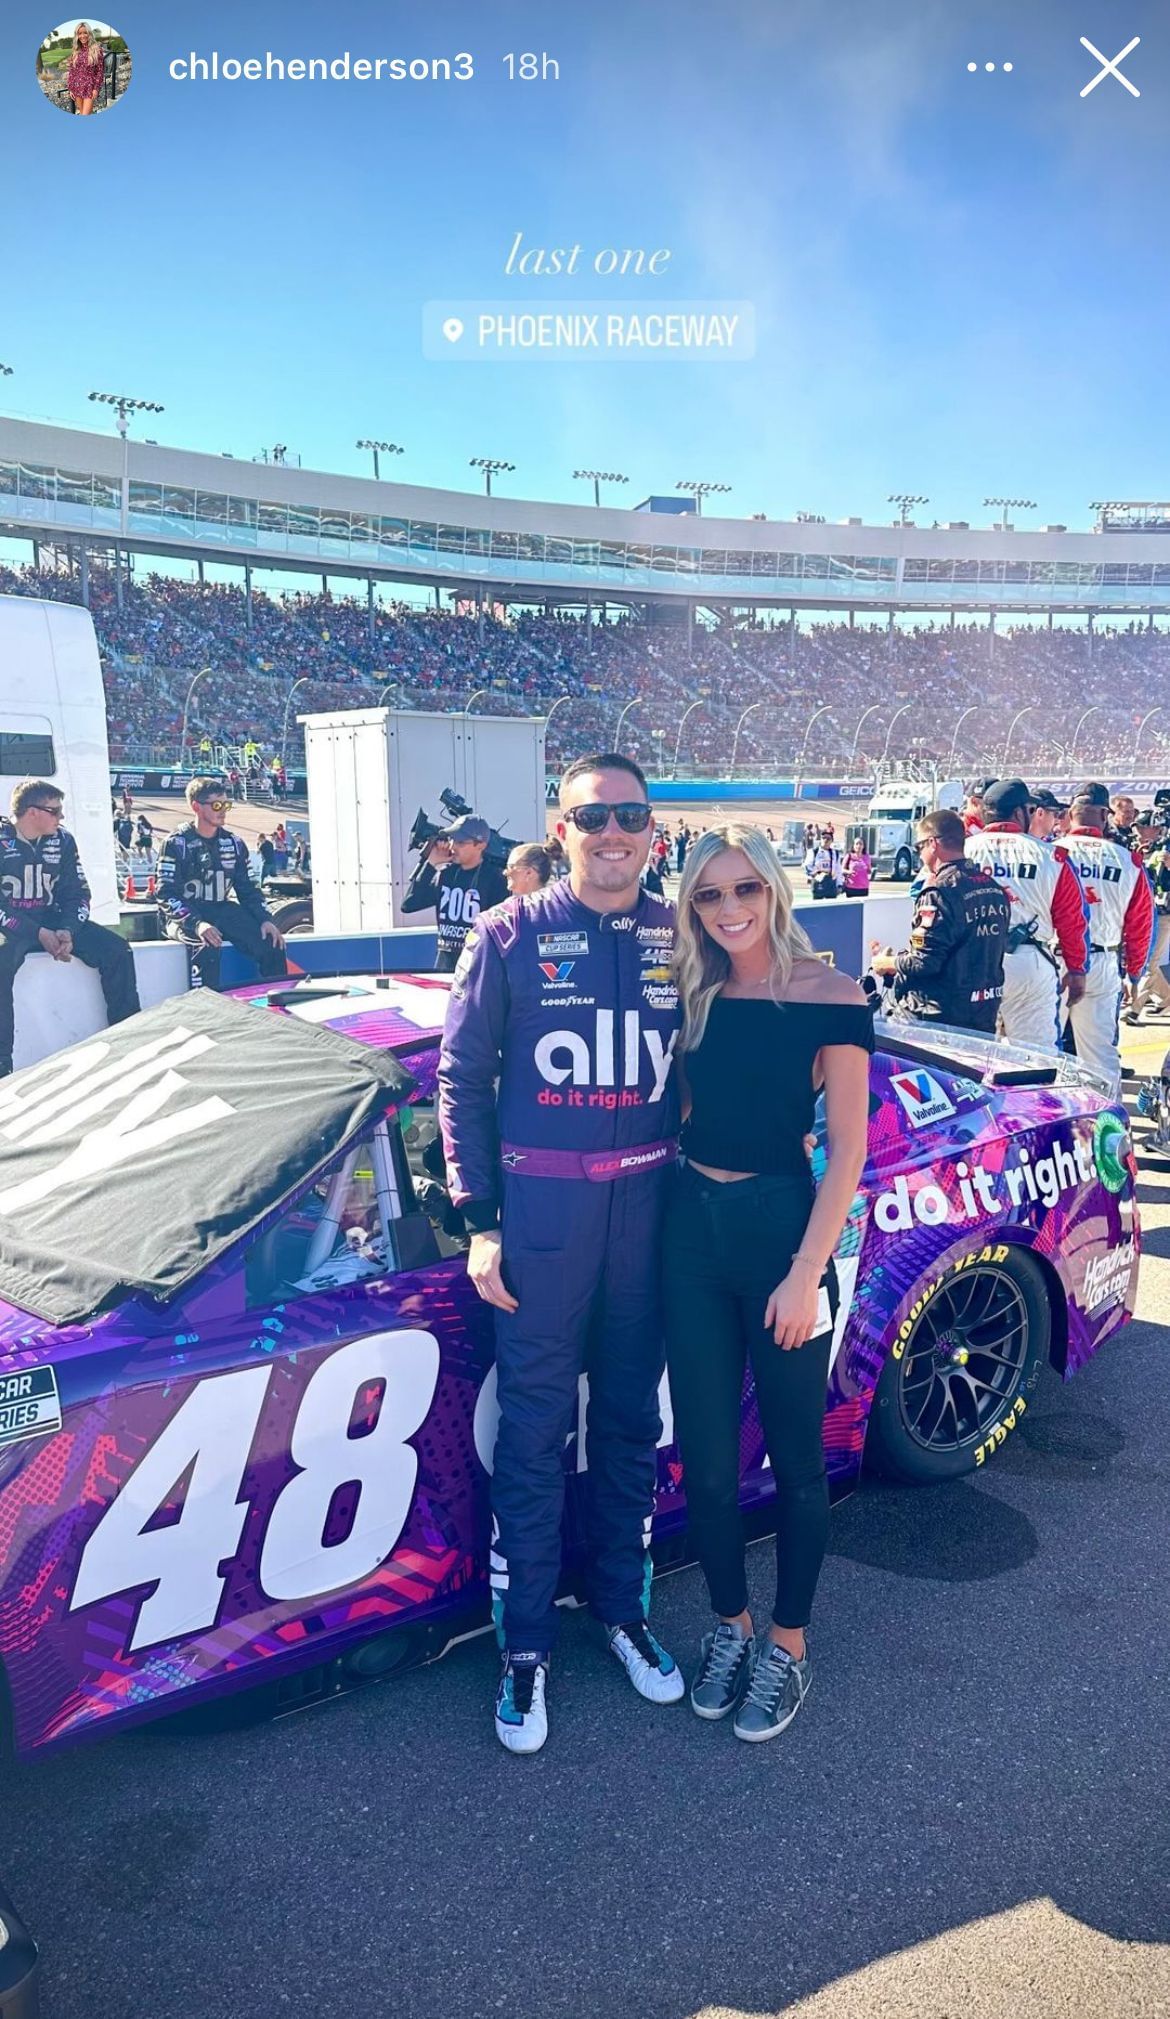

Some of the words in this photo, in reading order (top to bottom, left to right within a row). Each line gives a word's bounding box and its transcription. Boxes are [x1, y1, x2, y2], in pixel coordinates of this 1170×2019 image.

[440, 885, 480, 924] 206
[611, 917, 637, 932] ally
[542, 982, 576, 990] Valvoline
[534, 1009, 680, 1104] ally
[537, 1089, 563, 1106] do
[568, 1089, 583, 1107] it
[588, 1088, 644, 1110] right.
[912, 1102, 950, 1121] Valvoline
[873, 1175, 950, 1233] do
[956, 1161, 1002, 1218] it
[0, 1374, 33, 1400] CAR
[0, 1402, 39, 1430] RIES
[69, 1328, 441, 1653] 48
